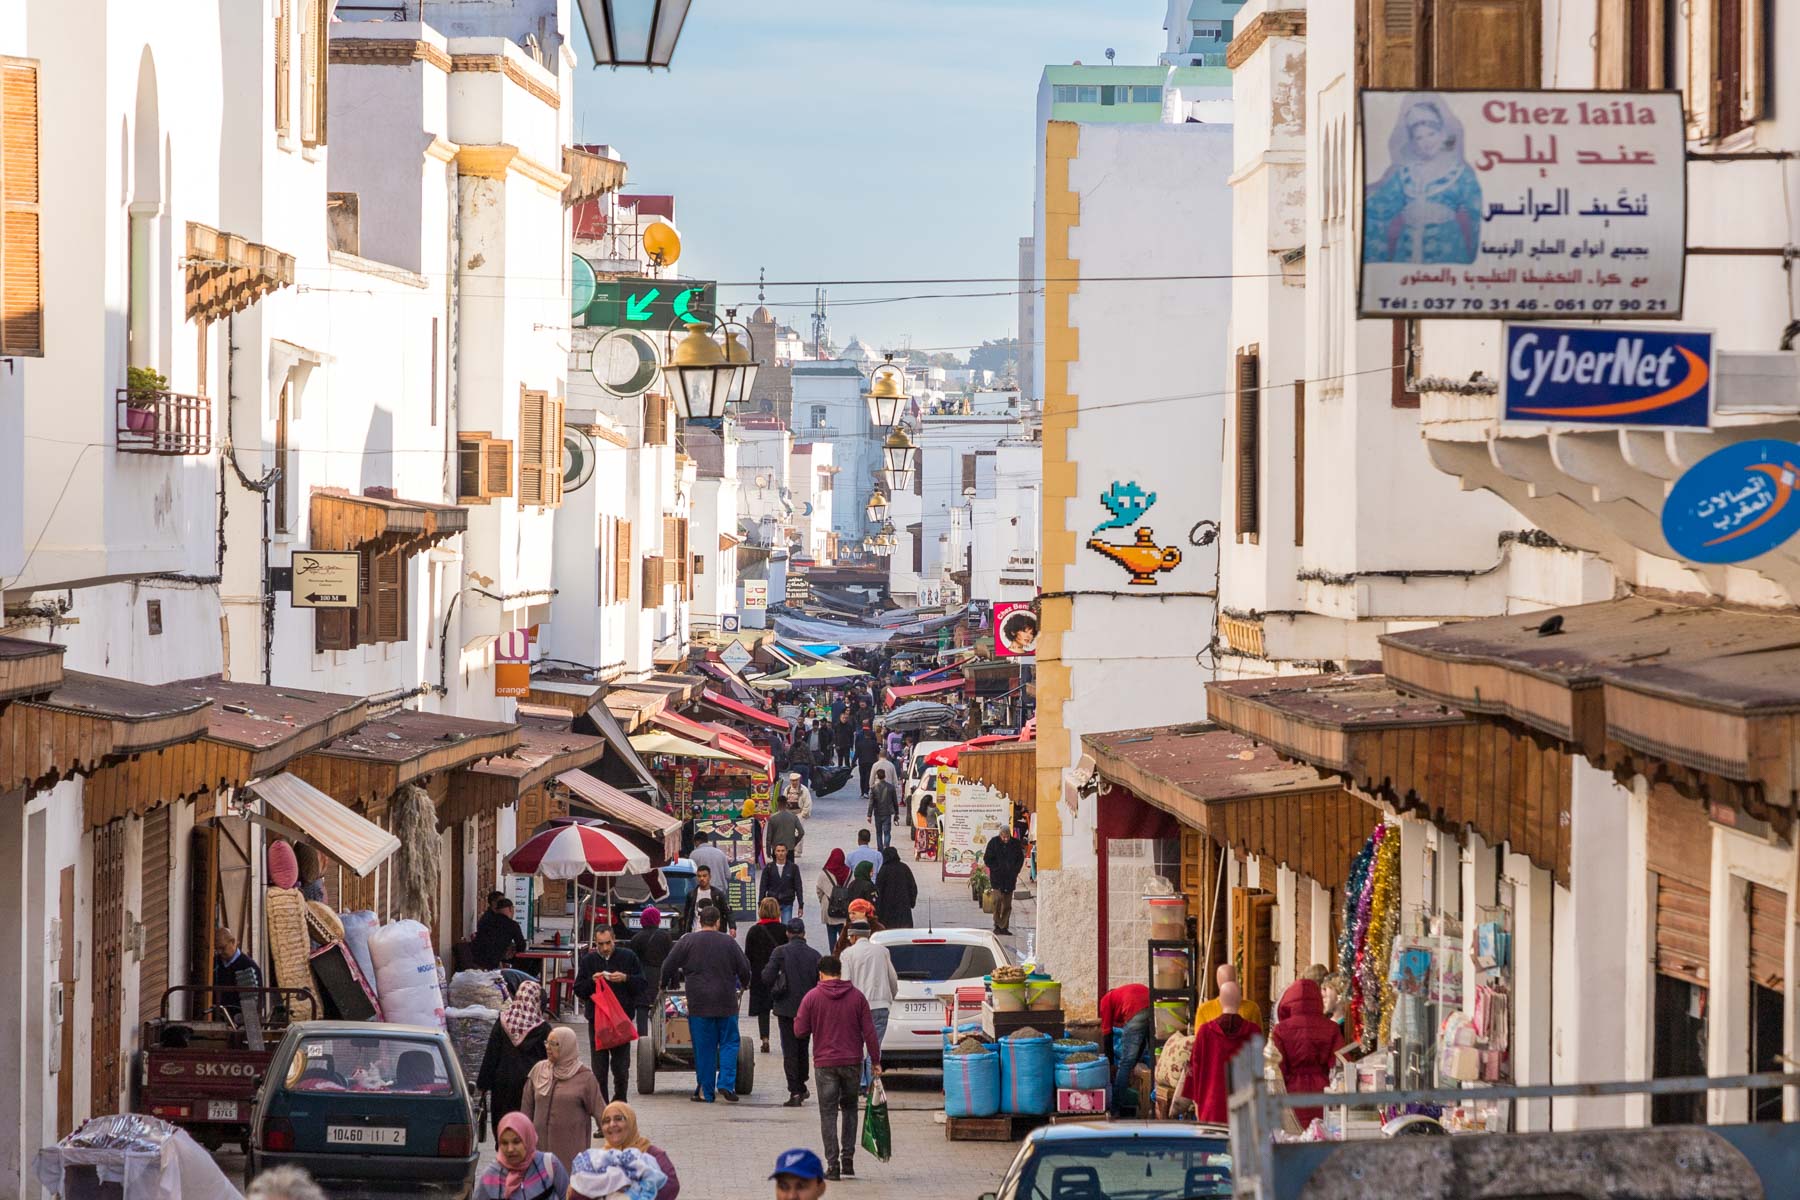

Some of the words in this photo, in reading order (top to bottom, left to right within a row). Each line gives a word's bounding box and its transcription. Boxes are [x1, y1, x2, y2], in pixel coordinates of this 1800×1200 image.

[1482, 99, 1569, 125] Chez
[1577, 101, 1657, 125] laila
[1577, 144, 1657, 165] عند
[1423, 299, 1456, 310] 037
[1461, 299, 1484, 310] 70
[1489, 299, 1510, 310] 31
[1516, 299, 1538, 310] 46
[1554, 299, 1586, 311] 061
[1592, 299, 1614, 311] 07
[1619, 299, 1642, 311] 90
[1647, 300, 1667, 311] 21
[1509, 333, 1675, 396] CyberNet
[496, 687, 527, 696] orange
[905, 1003, 927, 1012] 91375
[195, 1063, 255, 1077] SKYGO
[333, 1128, 363, 1142] 10460
[393, 1130, 400, 1143] 2
